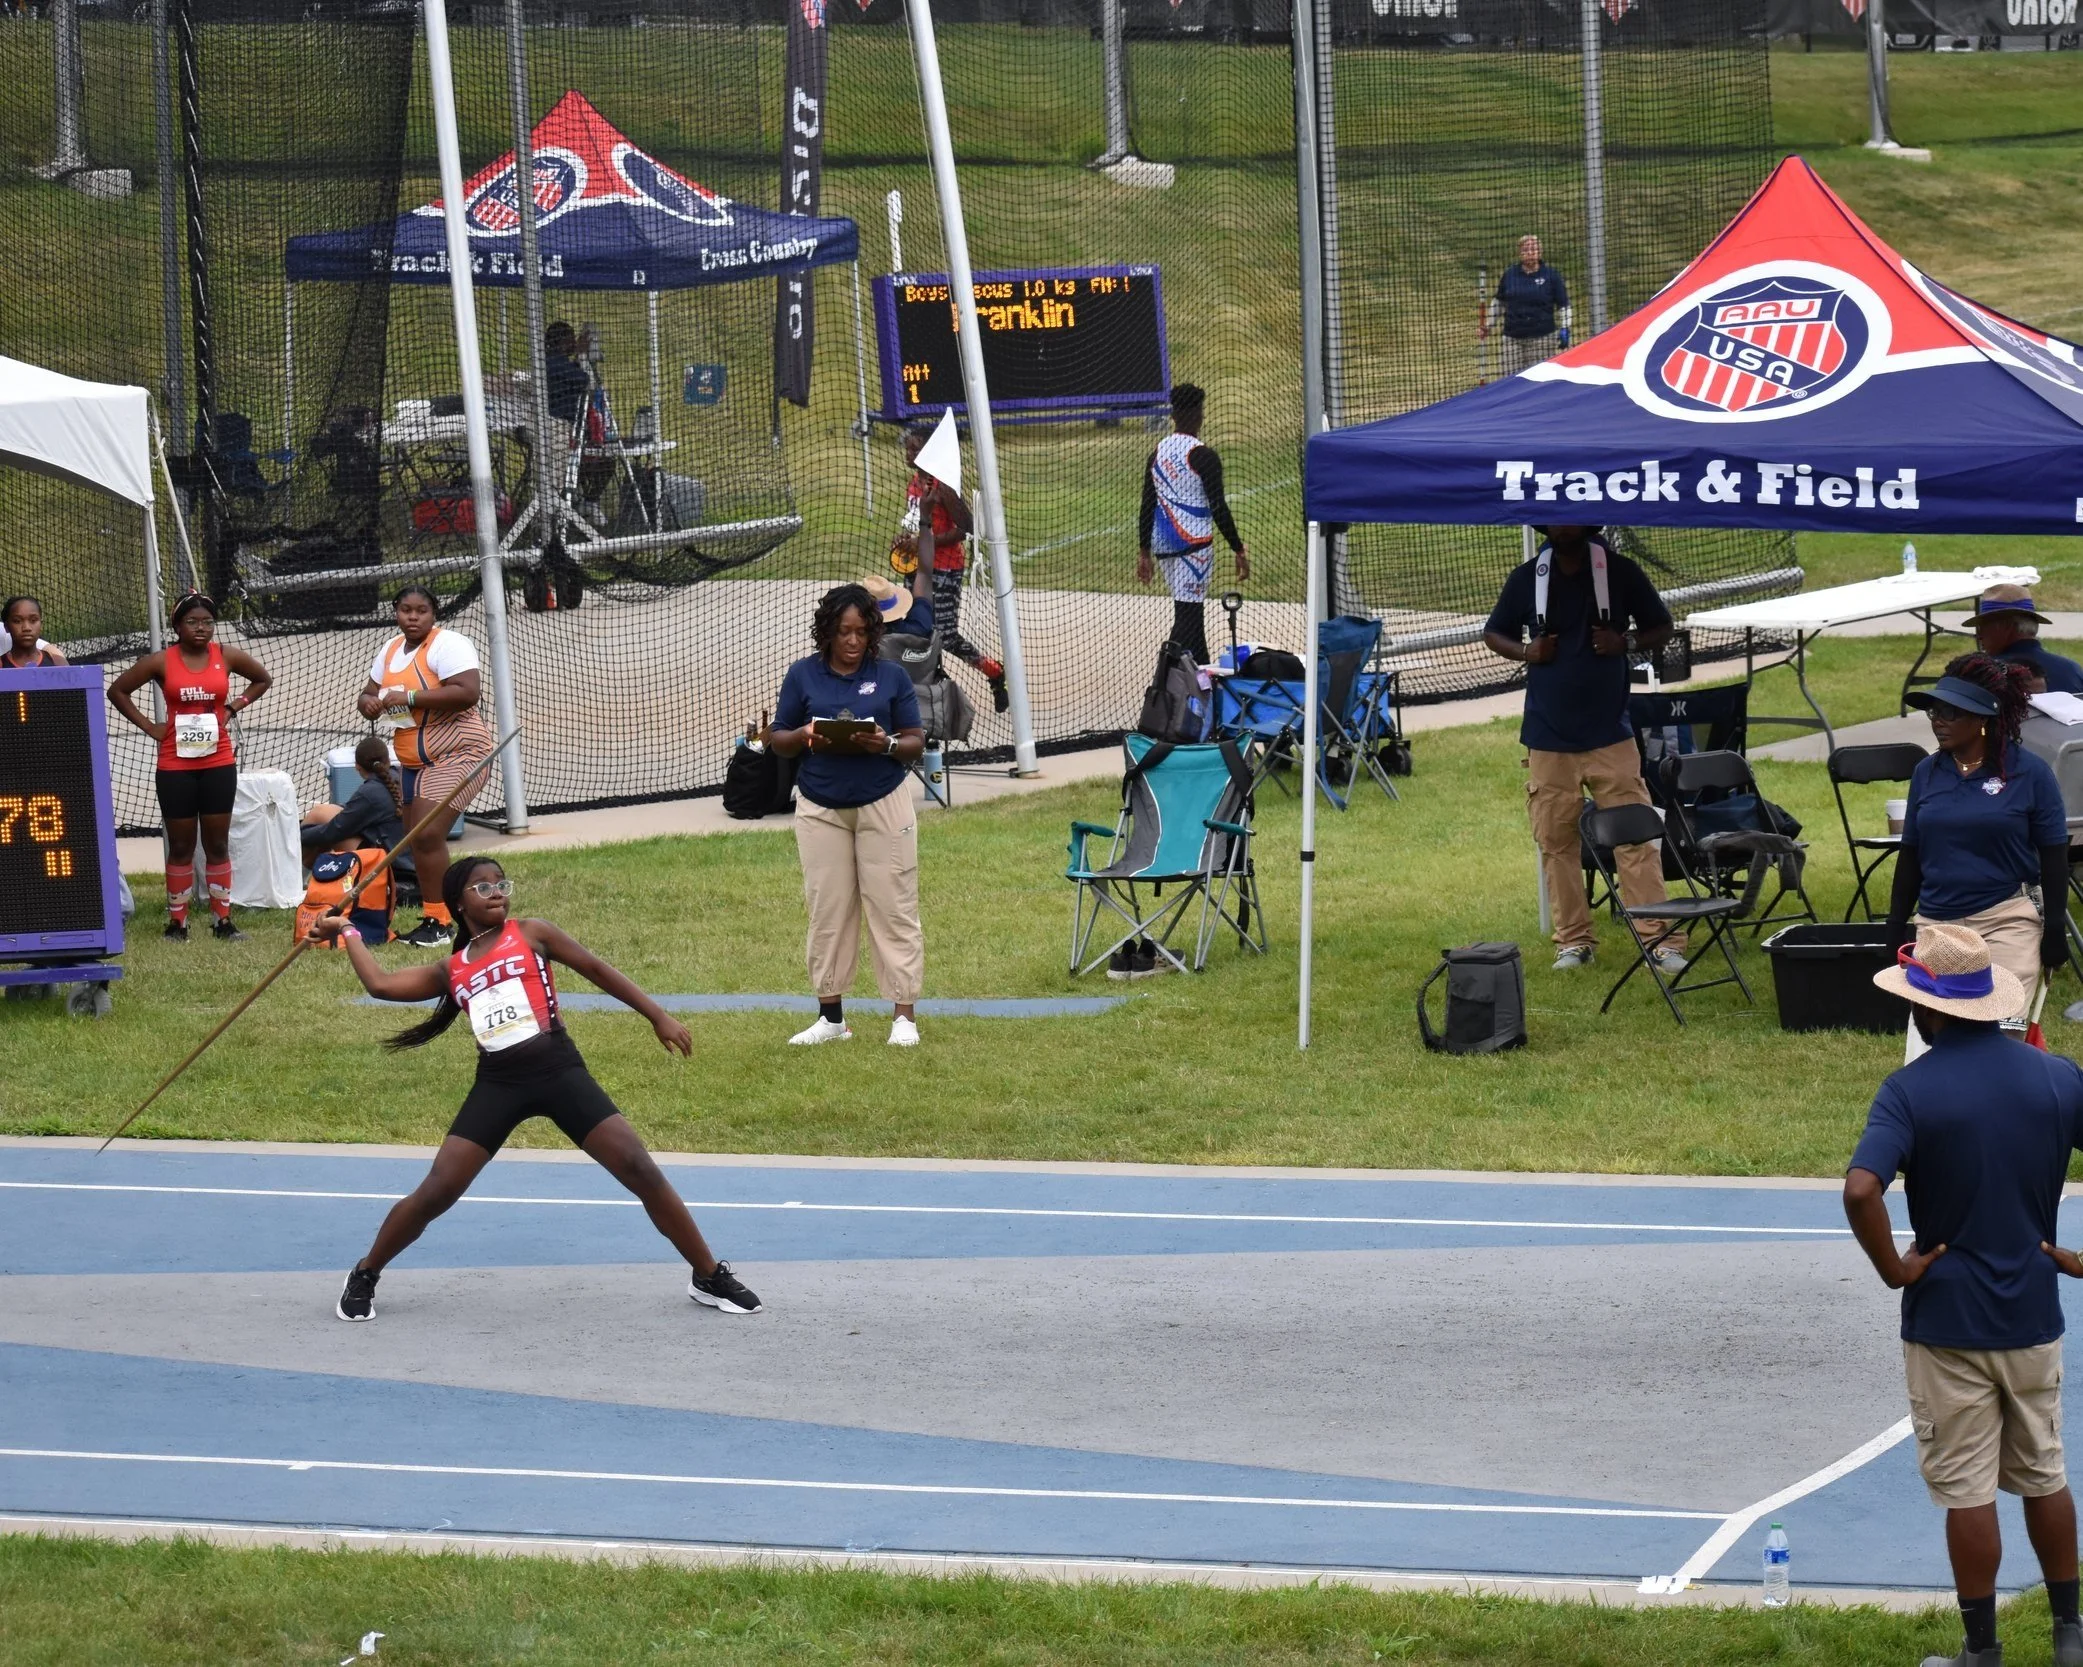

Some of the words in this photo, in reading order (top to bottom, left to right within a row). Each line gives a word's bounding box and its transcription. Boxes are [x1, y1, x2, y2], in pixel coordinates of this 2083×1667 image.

[701, 248, 747, 270] Cross
[905, 284, 948, 302] Boys
[971, 283, 1013, 299] scus
[1024, 280, 1046, 297] 1.0
[951, 298, 1076, 332] ranklin
[1720, 300, 1816, 323] AAU
[1709, 336, 1794, 385] USA
[909, 383, 920, 404] 1
[1495, 460, 1680, 502] Track
[1696, 459, 1741, 503] &
[1757, 462, 1920, 509] Field
[180, 686, 205, 696] FULL
[181, 693, 216, 702] STRIDE
[182, 731, 213, 743] 3297
[455, 954, 526, 1008] ASTC
[484, 1005, 518, 1029] 778
